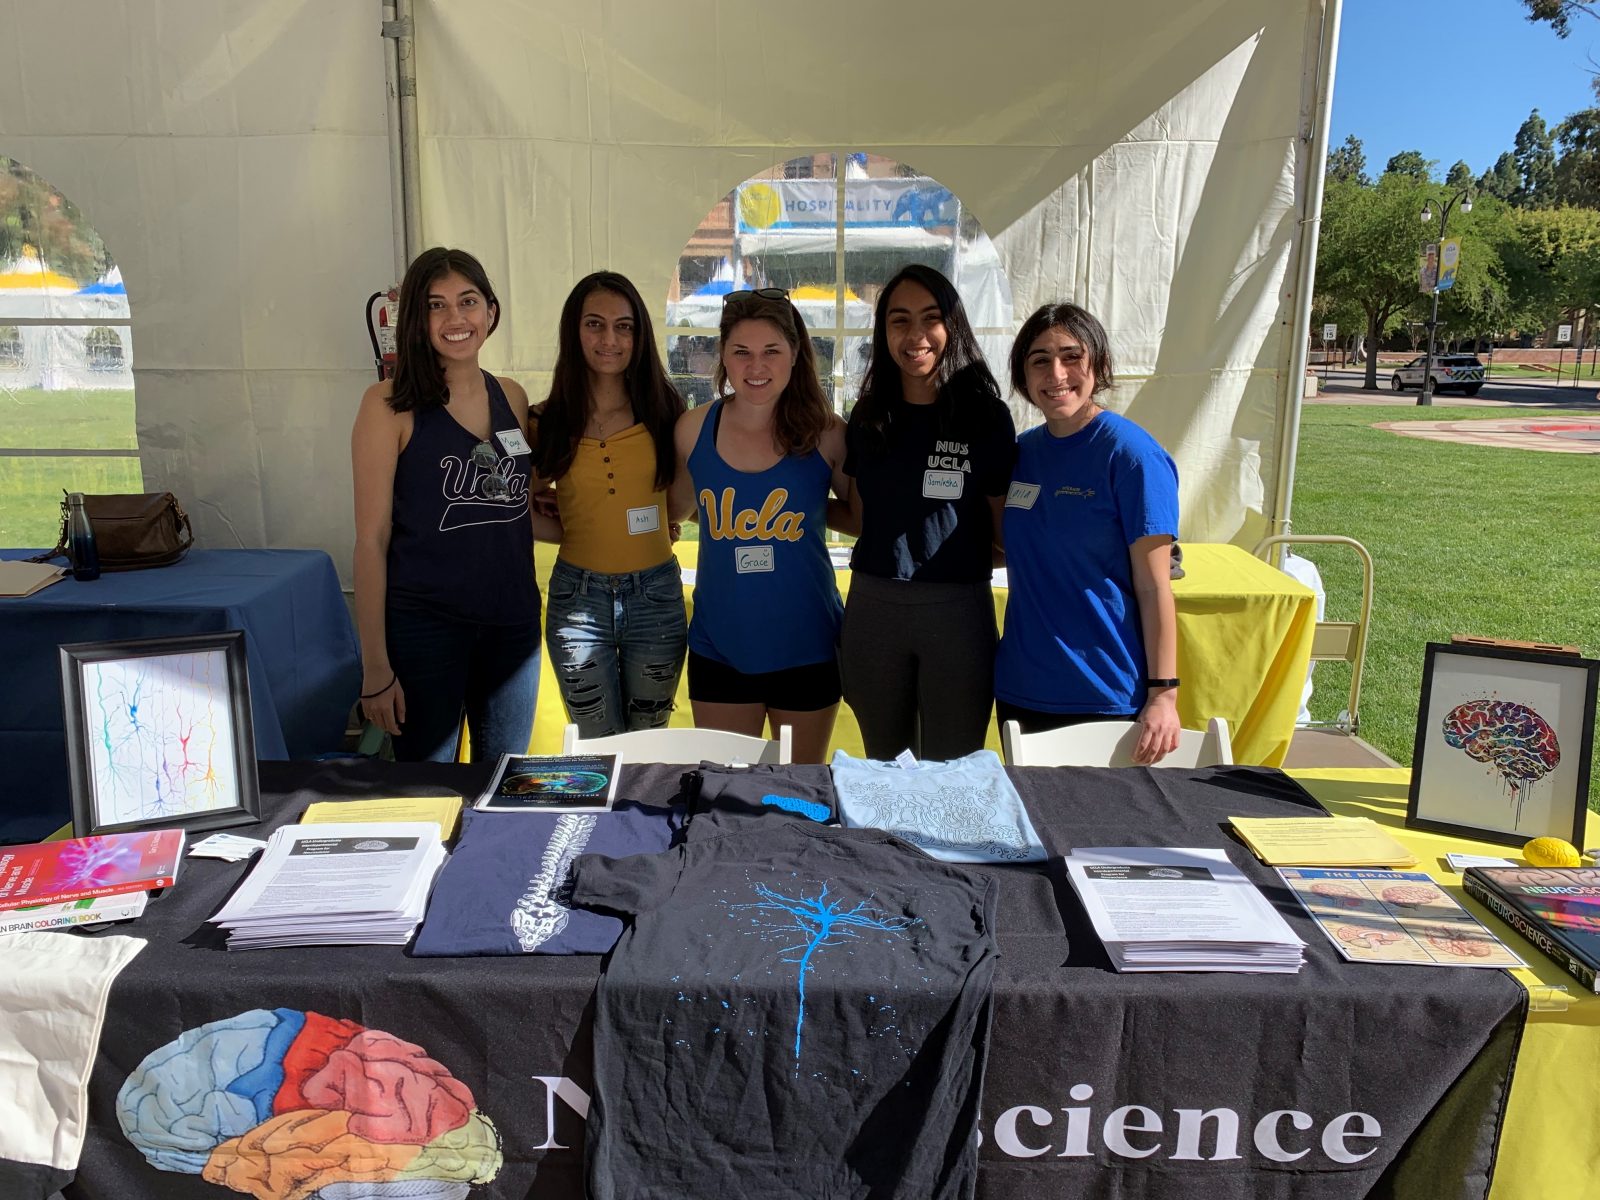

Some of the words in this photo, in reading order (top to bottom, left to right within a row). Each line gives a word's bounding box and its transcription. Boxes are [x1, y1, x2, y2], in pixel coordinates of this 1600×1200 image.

[785, 200, 892, 212] HOSPIALITY
[935, 440, 969, 455] NUS
[928, 455, 971, 473] UCLA
[740, 554, 769, 569] Grace
[20, 896, 53, 906] Physiology
[60, 892, 80, 900] Nerve
[92, 887, 114, 895] Muscle
[9, 922, 34, 931] BRAIN
[35, 916, 77, 929] COLORING
[79, 912, 102, 922] BOOK
[1487, 894, 1553, 954] NEUROSCIENCE
